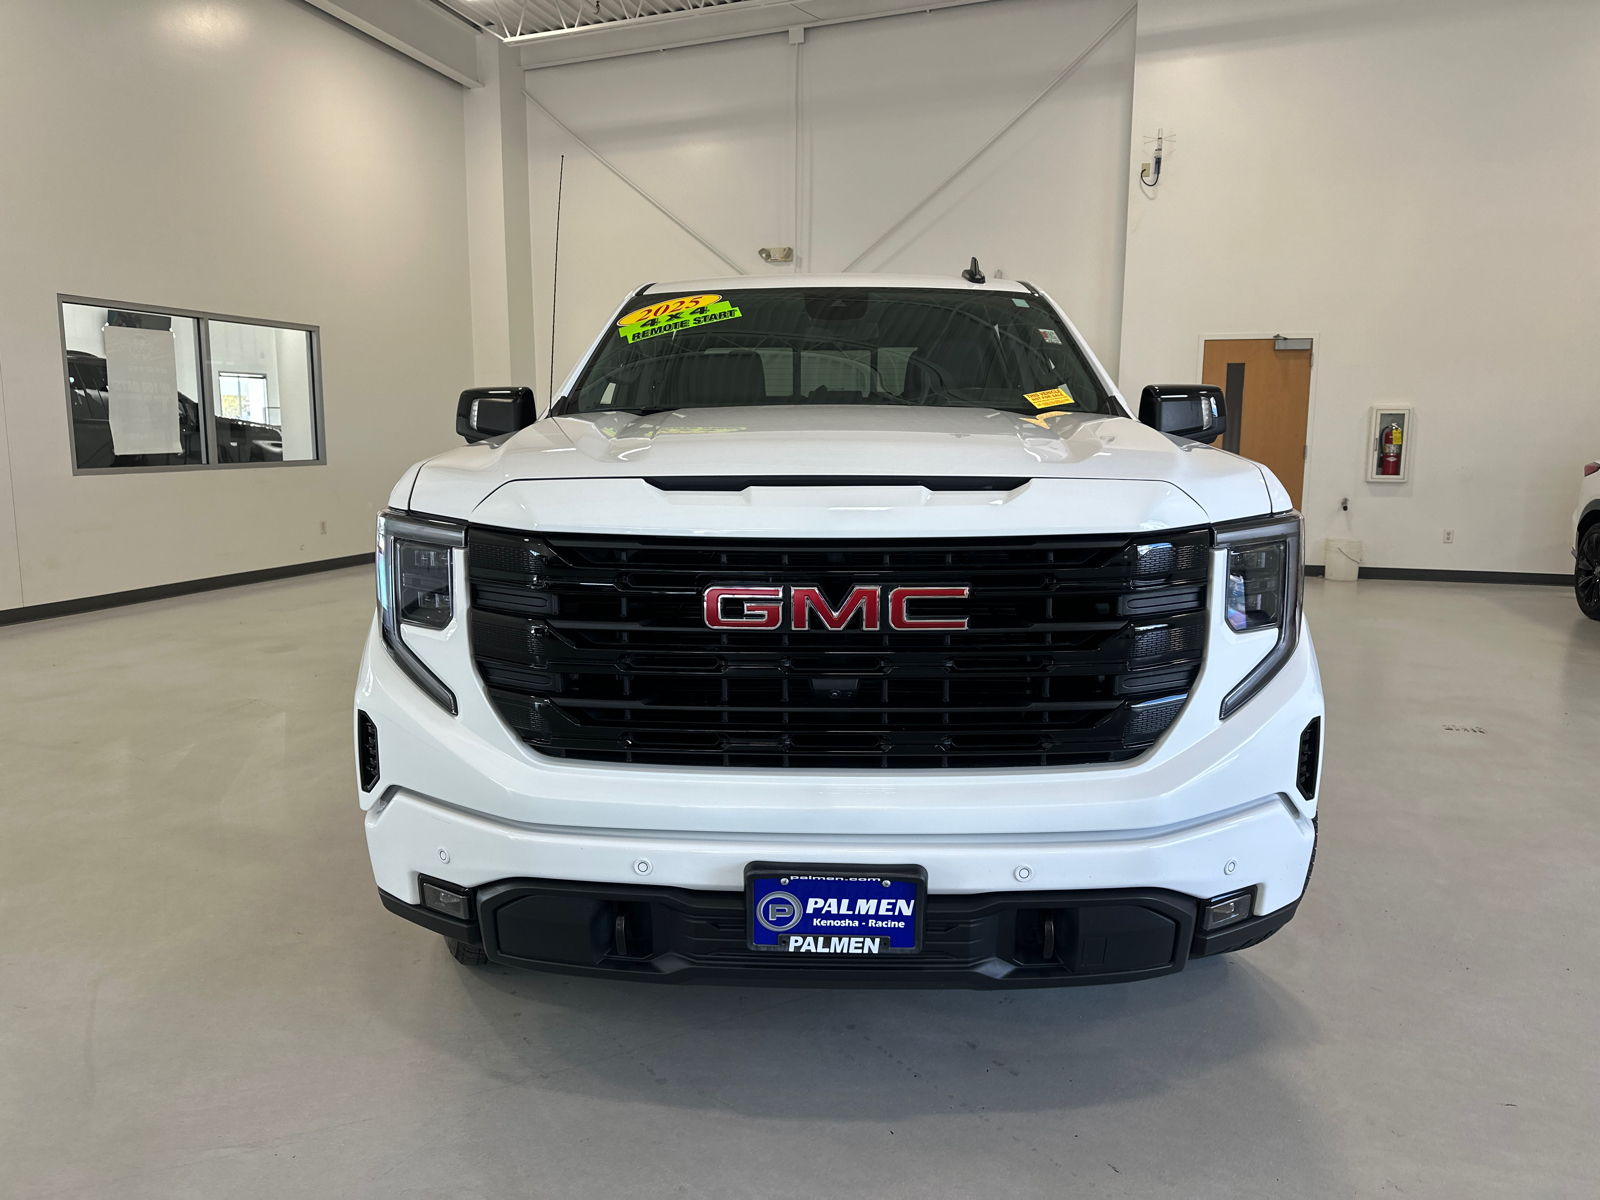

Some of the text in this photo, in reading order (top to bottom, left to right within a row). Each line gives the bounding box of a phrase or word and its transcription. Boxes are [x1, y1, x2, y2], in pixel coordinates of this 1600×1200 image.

[636, 296, 703, 322] 2025
[631, 309, 737, 341] REMOTE START
[1040, 389, 1061, 397] VEHICLE
[704, 585, 969, 631] GMC
[805, 897, 915, 916] PALMEN
[812, 918, 859, 928] Kenosha
[868, 919, 905, 928] Racine
[788, 935, 881, 954] PALMEN
